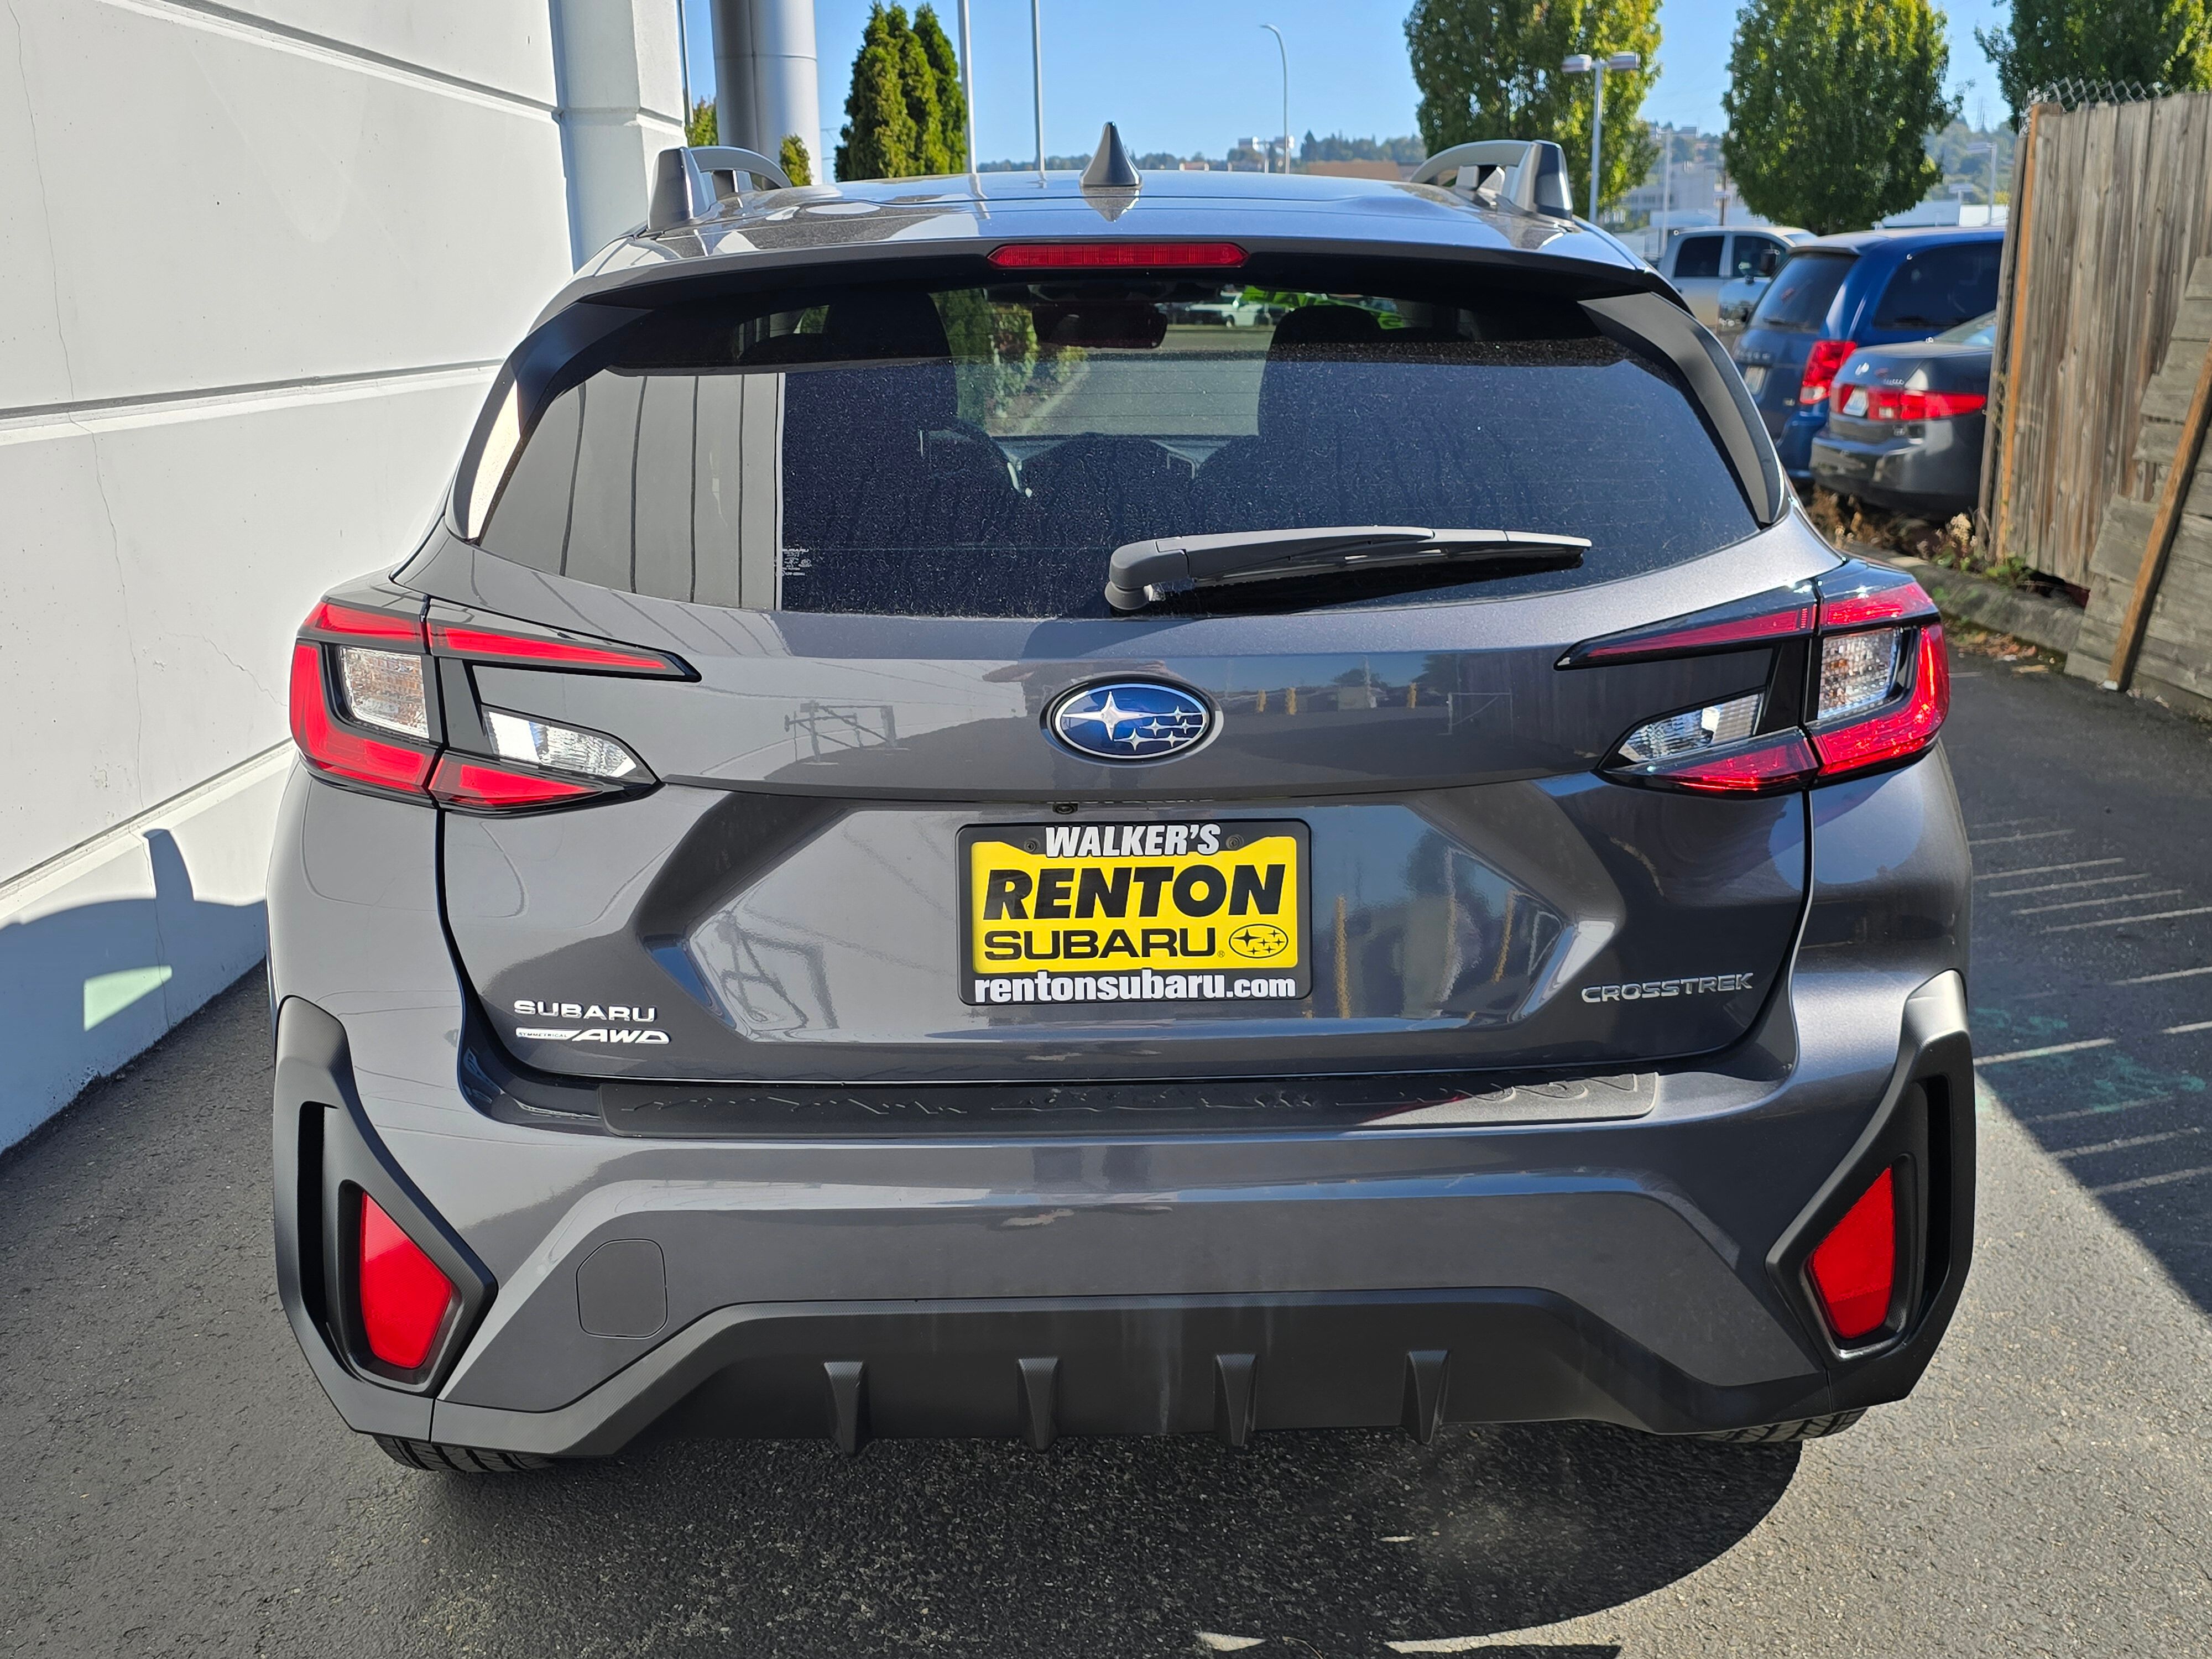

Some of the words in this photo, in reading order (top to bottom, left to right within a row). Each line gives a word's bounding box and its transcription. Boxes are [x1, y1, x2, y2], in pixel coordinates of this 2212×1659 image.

[1045, 824, 1221, 858] WALKER'S
[983, 864, 1286, 920] RENTON
[975, 969, 1296, 1003] rentonsubaru.com
[1581, 972, 1754, 1003] CROSSTREK
[514, 1000, 656, 1022] SUBARU
[572, 1029, 670, 1044] AWD
